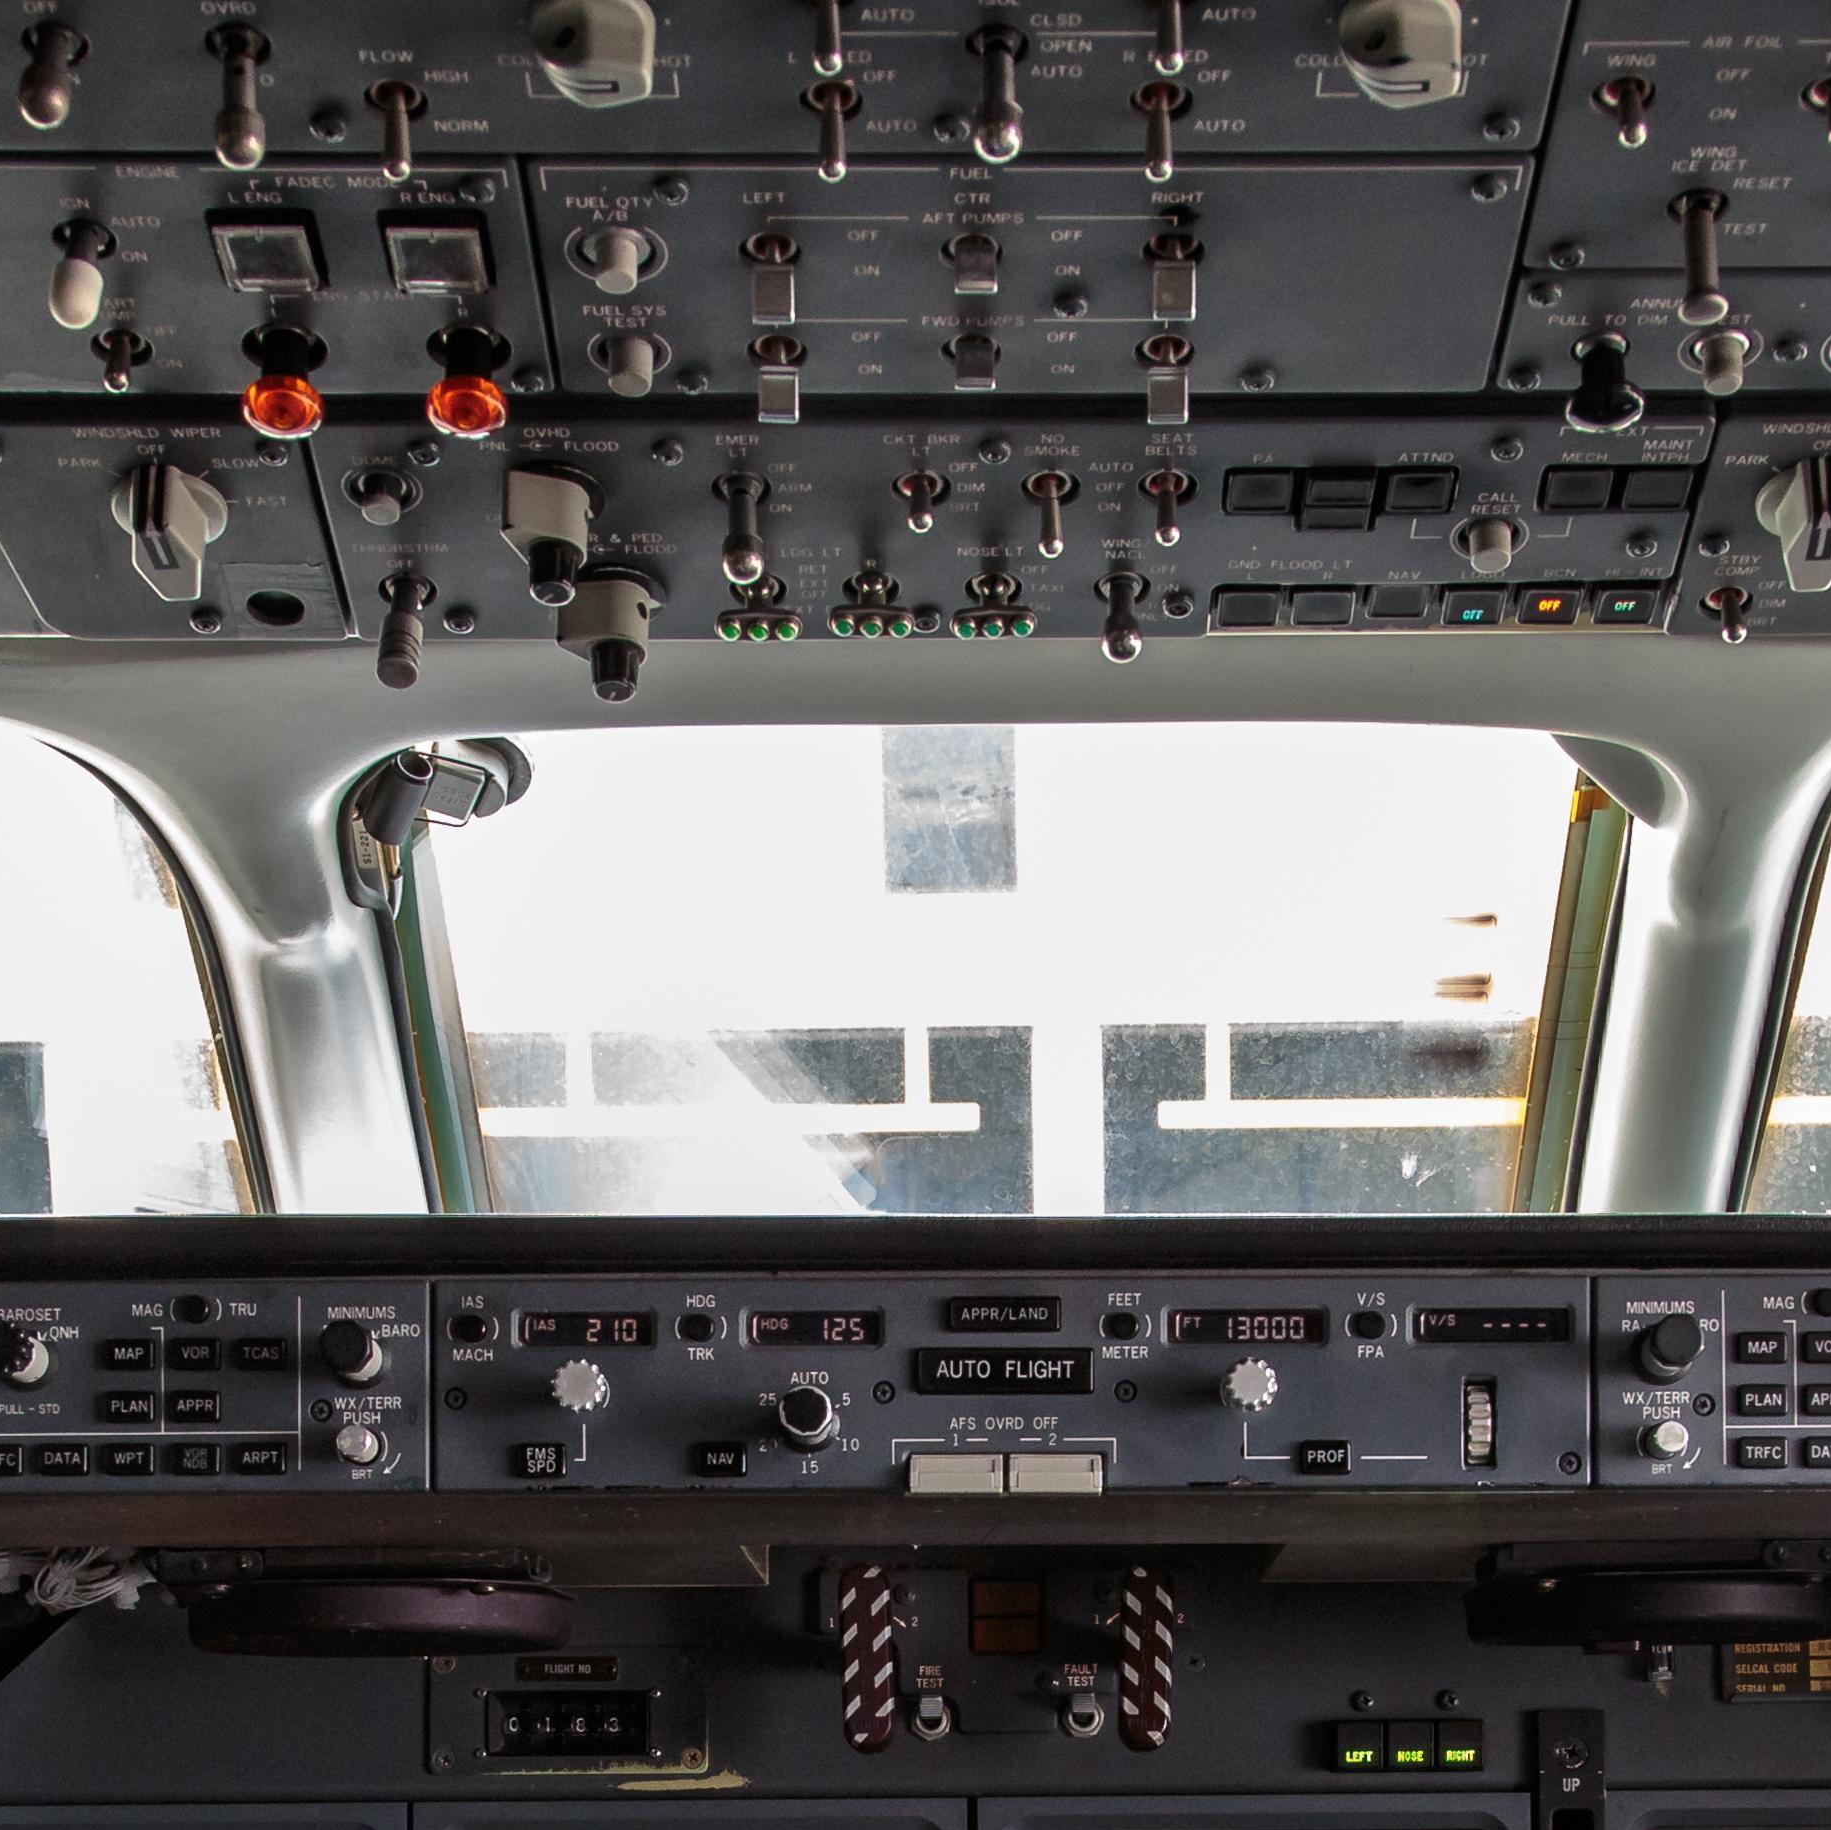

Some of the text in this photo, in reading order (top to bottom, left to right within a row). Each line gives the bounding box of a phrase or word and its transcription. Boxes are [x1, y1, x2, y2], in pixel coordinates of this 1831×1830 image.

[1701, 35, 1783, 49] AIR FOIL
[358, 50, 414, 64] FLOW
[949, 167, 993, 180] FUEL
[275, 176, 338, 189] FADEC
[742, 192, 785, 204] LEFT
[954, 192, 990, 205] CTR
[1151, 191, 1204, 205] RIGHT
[922, 213, 1024, 225] AFT PUMPS
[583, 306, 666, 318] FUEL SYS
[604, 317, 647, 328] TEST
[71, 427, 221, 439] WINDSHLD WIPER
[1151, 433, 1194, 445] SEAT
[1024, 446, 1080, 457] SMOKE
[1145, 446, 1197, 457] BELTS
[1397, 452, 1455, 463] ATTND
[1477, 493, 1518, 503] CALL
[1471, 504, 1521, 515] RESET
[1108, 1293, 1141, 1306] FEET
[327, 1306, 396, 1319] MINIMUMS
[1626, 1300, 1695, 1314] MINIMUMS
[961, 1307, 1049, 1321] APPR/LAND
[533, 1319, 637, 1342] IAS 210
[760, 1318, 864, 1341] HDG 125
[1183, 1316, 1305, 1340] FT 13000
[114, 1347, 143, 1360] MAP
[452, 1348, 493, 1362] MACH
[687, 1347, 714, 1361] TRK
[1101, 1346, 1149, 1360] METER
[936, 1361, 1075, 1379] AUTO FLIGHT
[790, 1371, 830, 1386] AUTO
[334, 1396, 402, 1411] WX/TERR
[1745, 1393, 1782, 1406] PLAN
[343, 1411, 381, 1425] PUSH
[950, 1417, 1058, 1431] AFS OVRD OFF
[1307, 1450, 1345, 1464] PROF
[1734, 1643, 1801, 1654] REGISTRATION
[544, 1664, 592, 1674] FLIGHT NO
[919, 1666, 941, 1676] FIRE
[1064, 1664, 1098, 1675] FAULT
[1735, 1663, 1798, 1674] SELCAL CODE
[916, 1678, 944, 1689] TEST
[1344, 1750, 1373, 1763] LEFT
[1445, 1750, 1476, 1763] RIGHT
